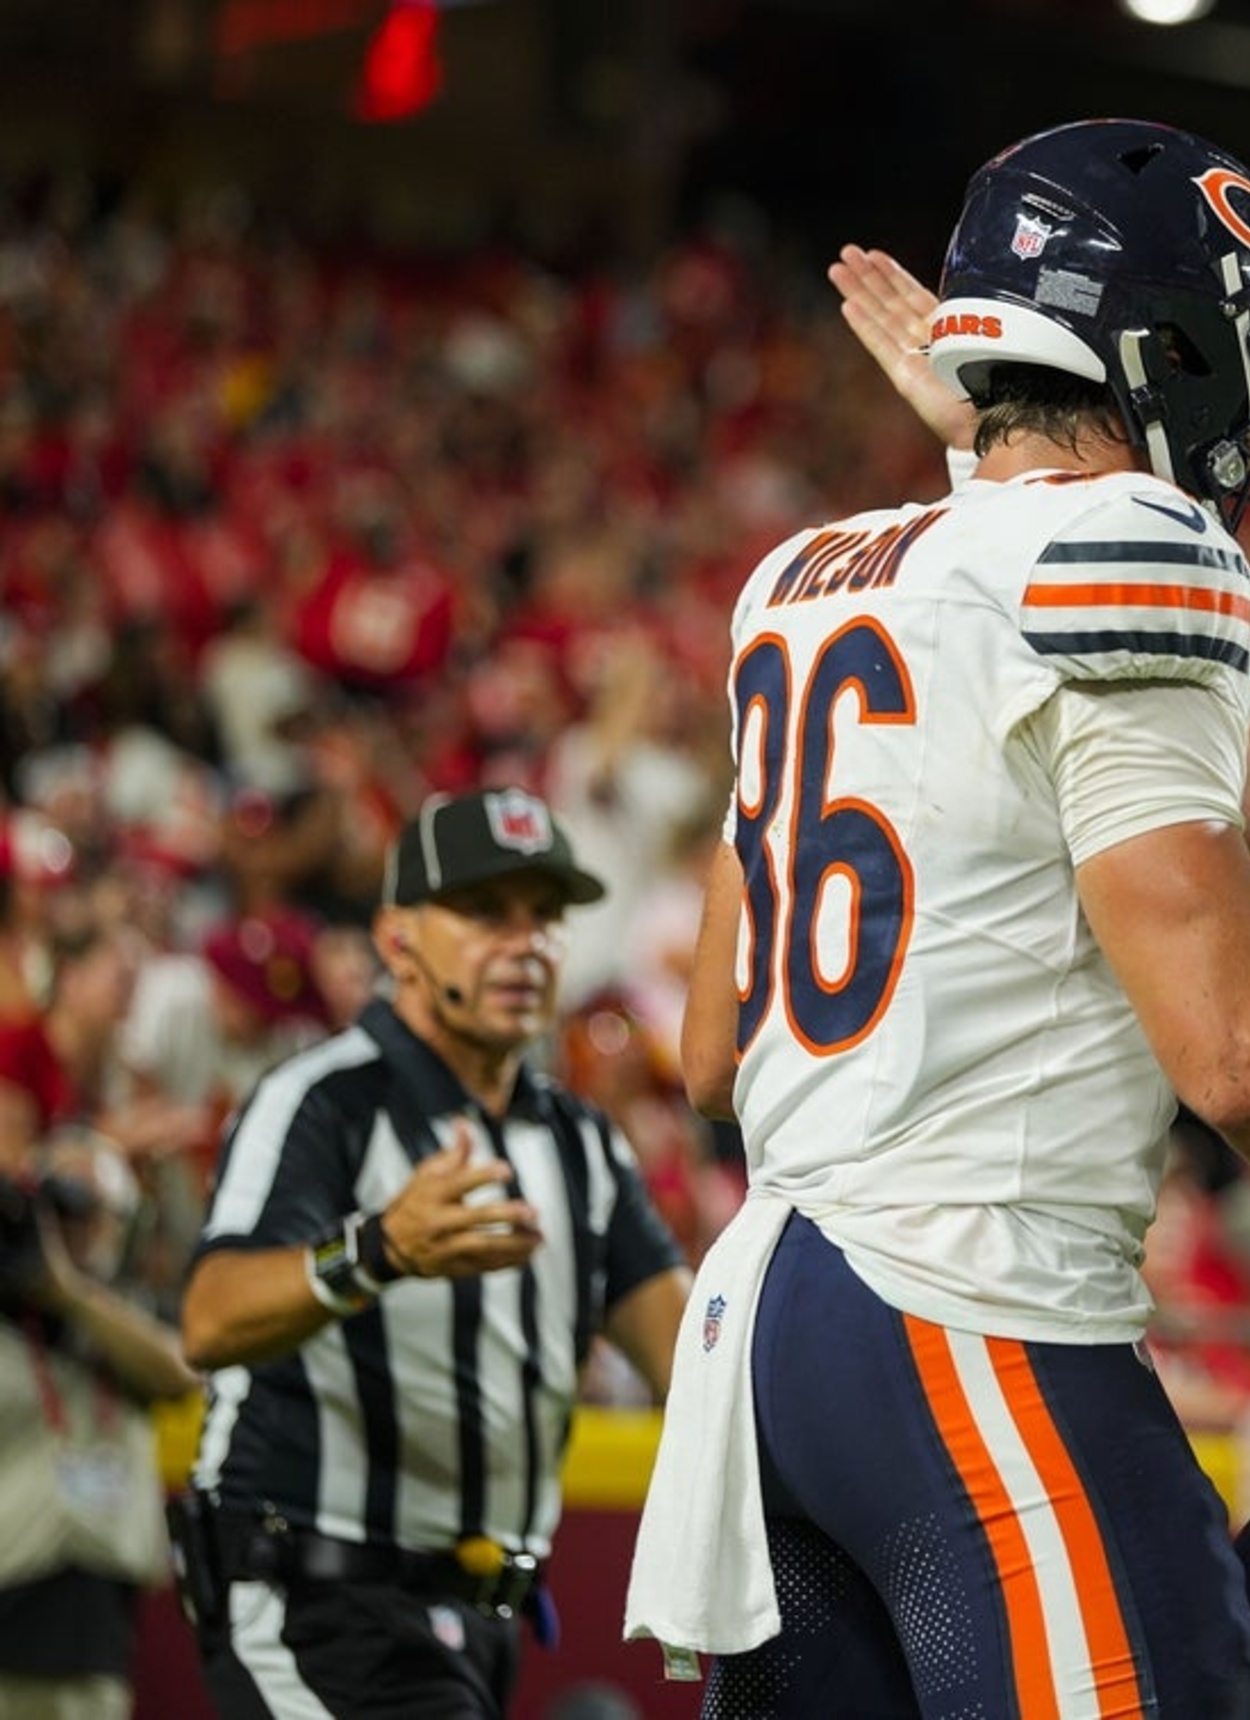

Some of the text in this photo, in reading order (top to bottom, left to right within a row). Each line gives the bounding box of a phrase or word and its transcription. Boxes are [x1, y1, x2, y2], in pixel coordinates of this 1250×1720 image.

[931, 313, 1003, 340] EARS
[765, 507, 950, 609] WILSON
[734, 614, 917, 1066] 86
